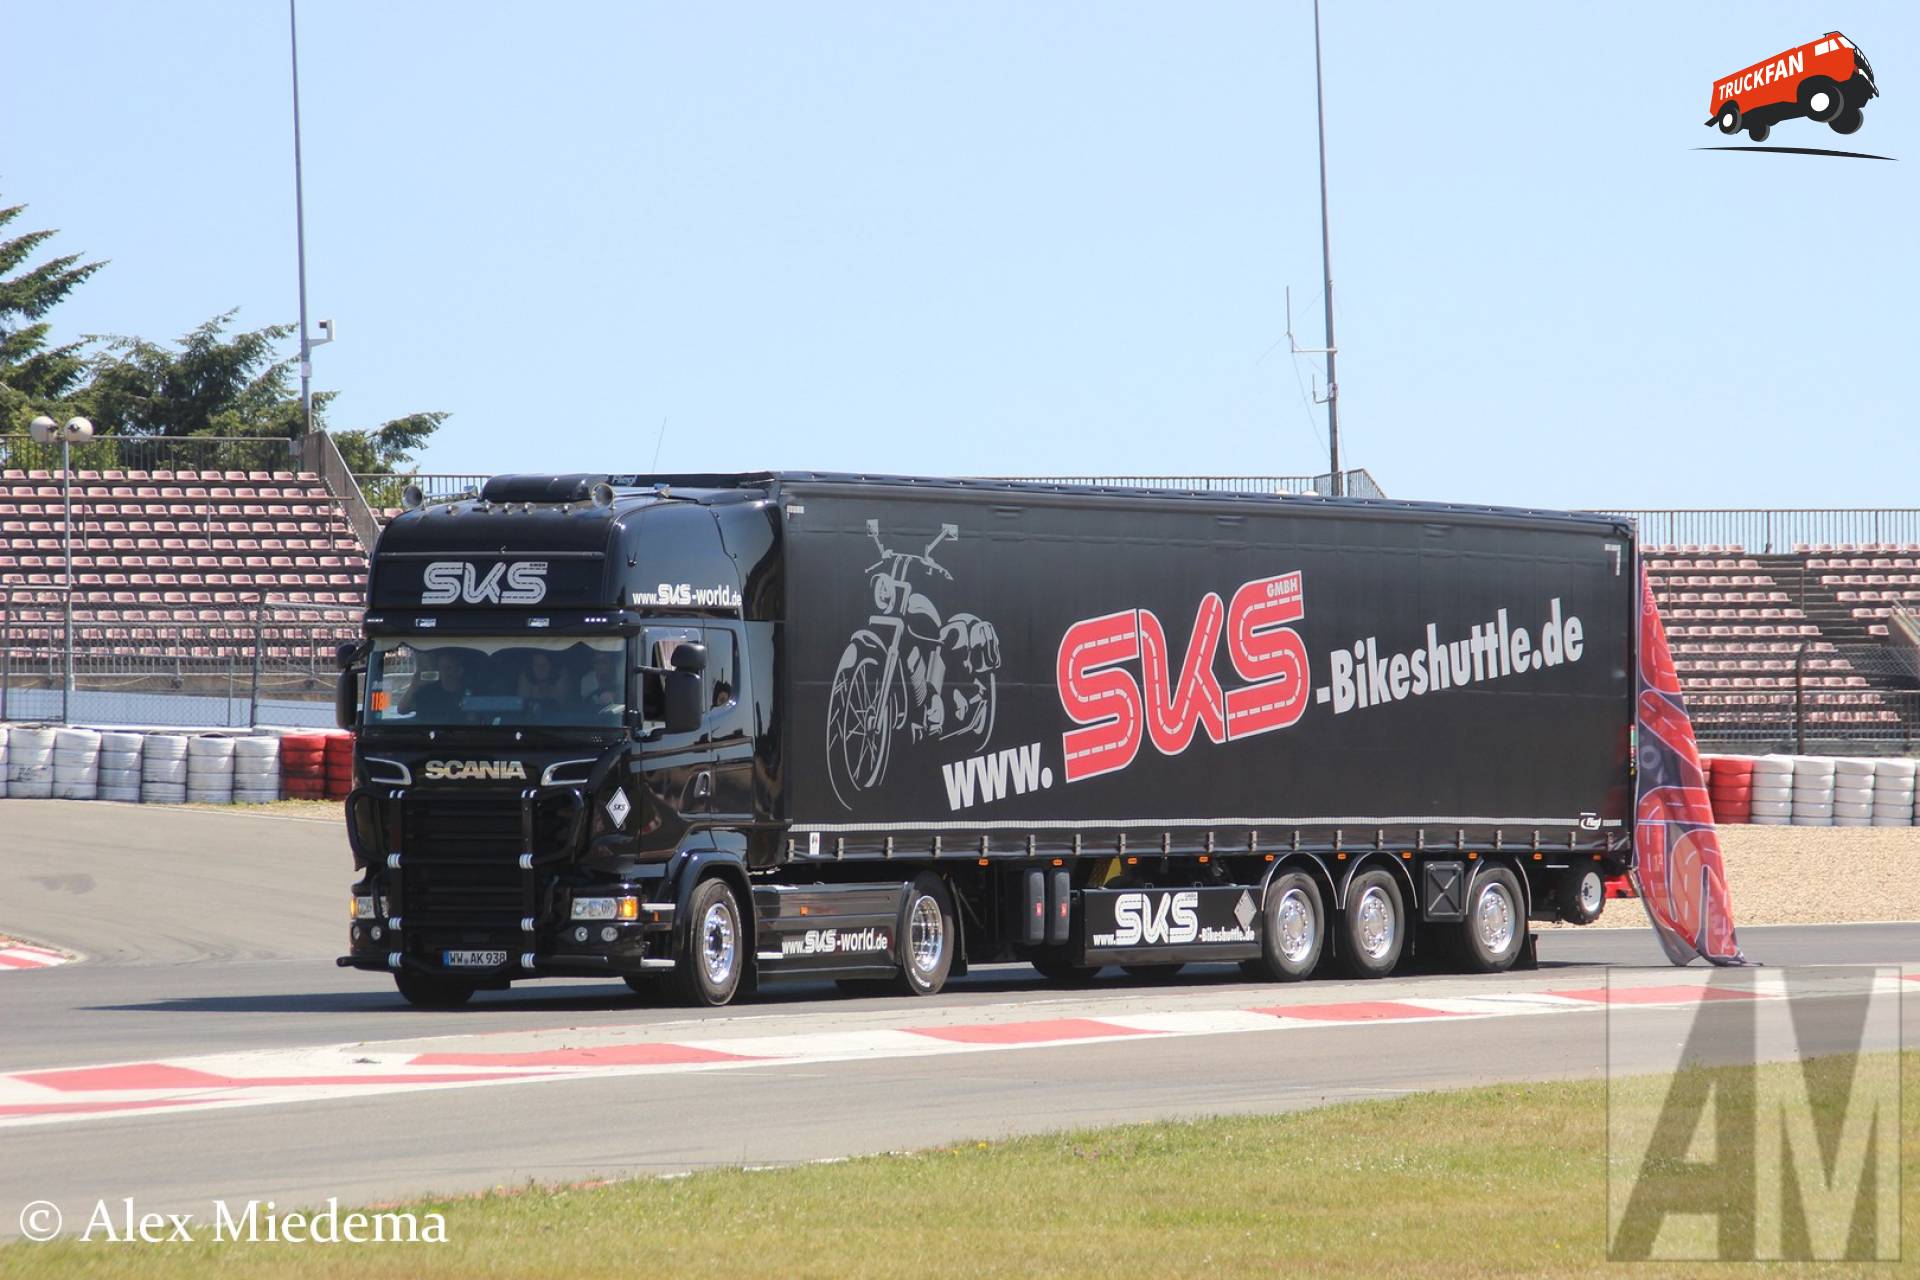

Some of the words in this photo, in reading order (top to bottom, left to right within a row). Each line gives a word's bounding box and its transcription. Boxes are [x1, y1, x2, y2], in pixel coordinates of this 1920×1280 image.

[421, 562, 548, 605] SKS
[1266, 577, 1298, 599] GMBH
[425, 760, 527, 780] SCANIA
